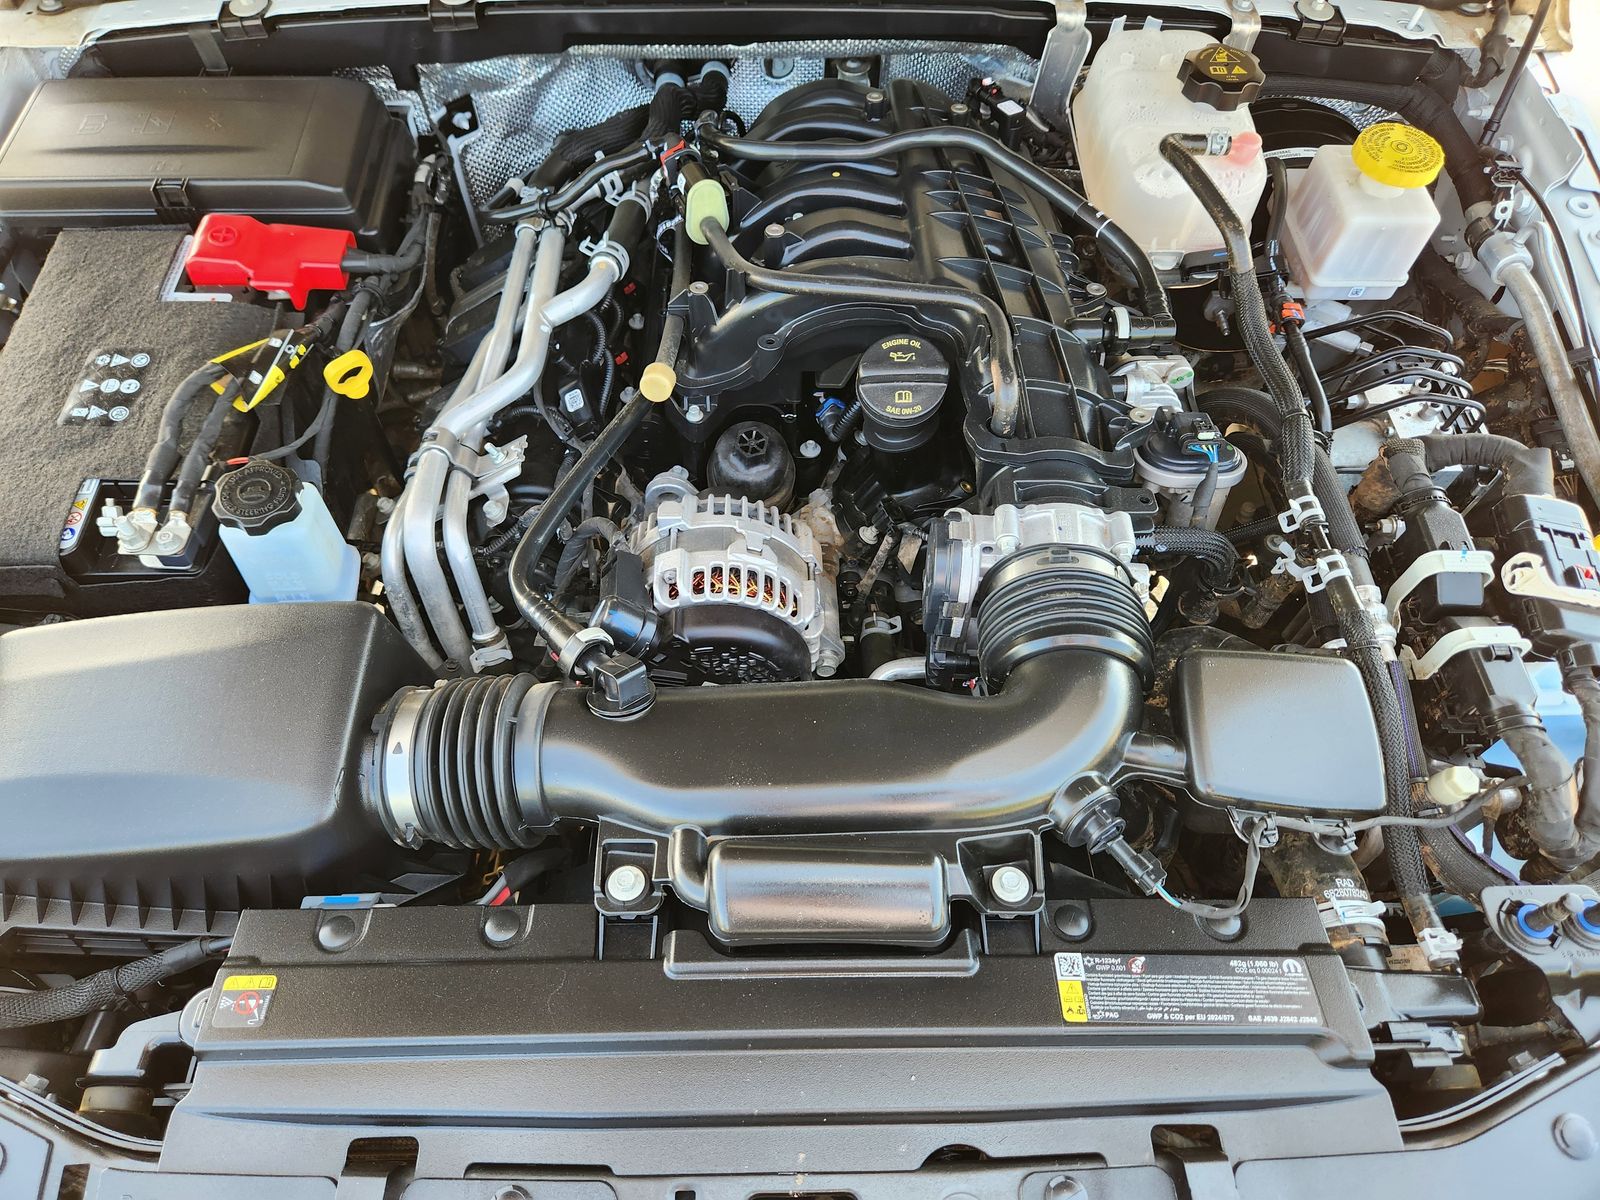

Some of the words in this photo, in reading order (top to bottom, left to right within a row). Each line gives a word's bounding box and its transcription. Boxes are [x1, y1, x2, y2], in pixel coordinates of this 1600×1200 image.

[881, 339, 908, 349] ENGINE
[910, 339, 921, 348] OIL
[886, 405, 900, 414] SAE
[902, 405, 921, 414] 0W-20
[237, 503, 273, 516] STEERING
[1335, 878, 1354, 887] RAD
[1104, 1011, 1119, 1019] PAG
[1196, 1013, 1206, 1021] EU
